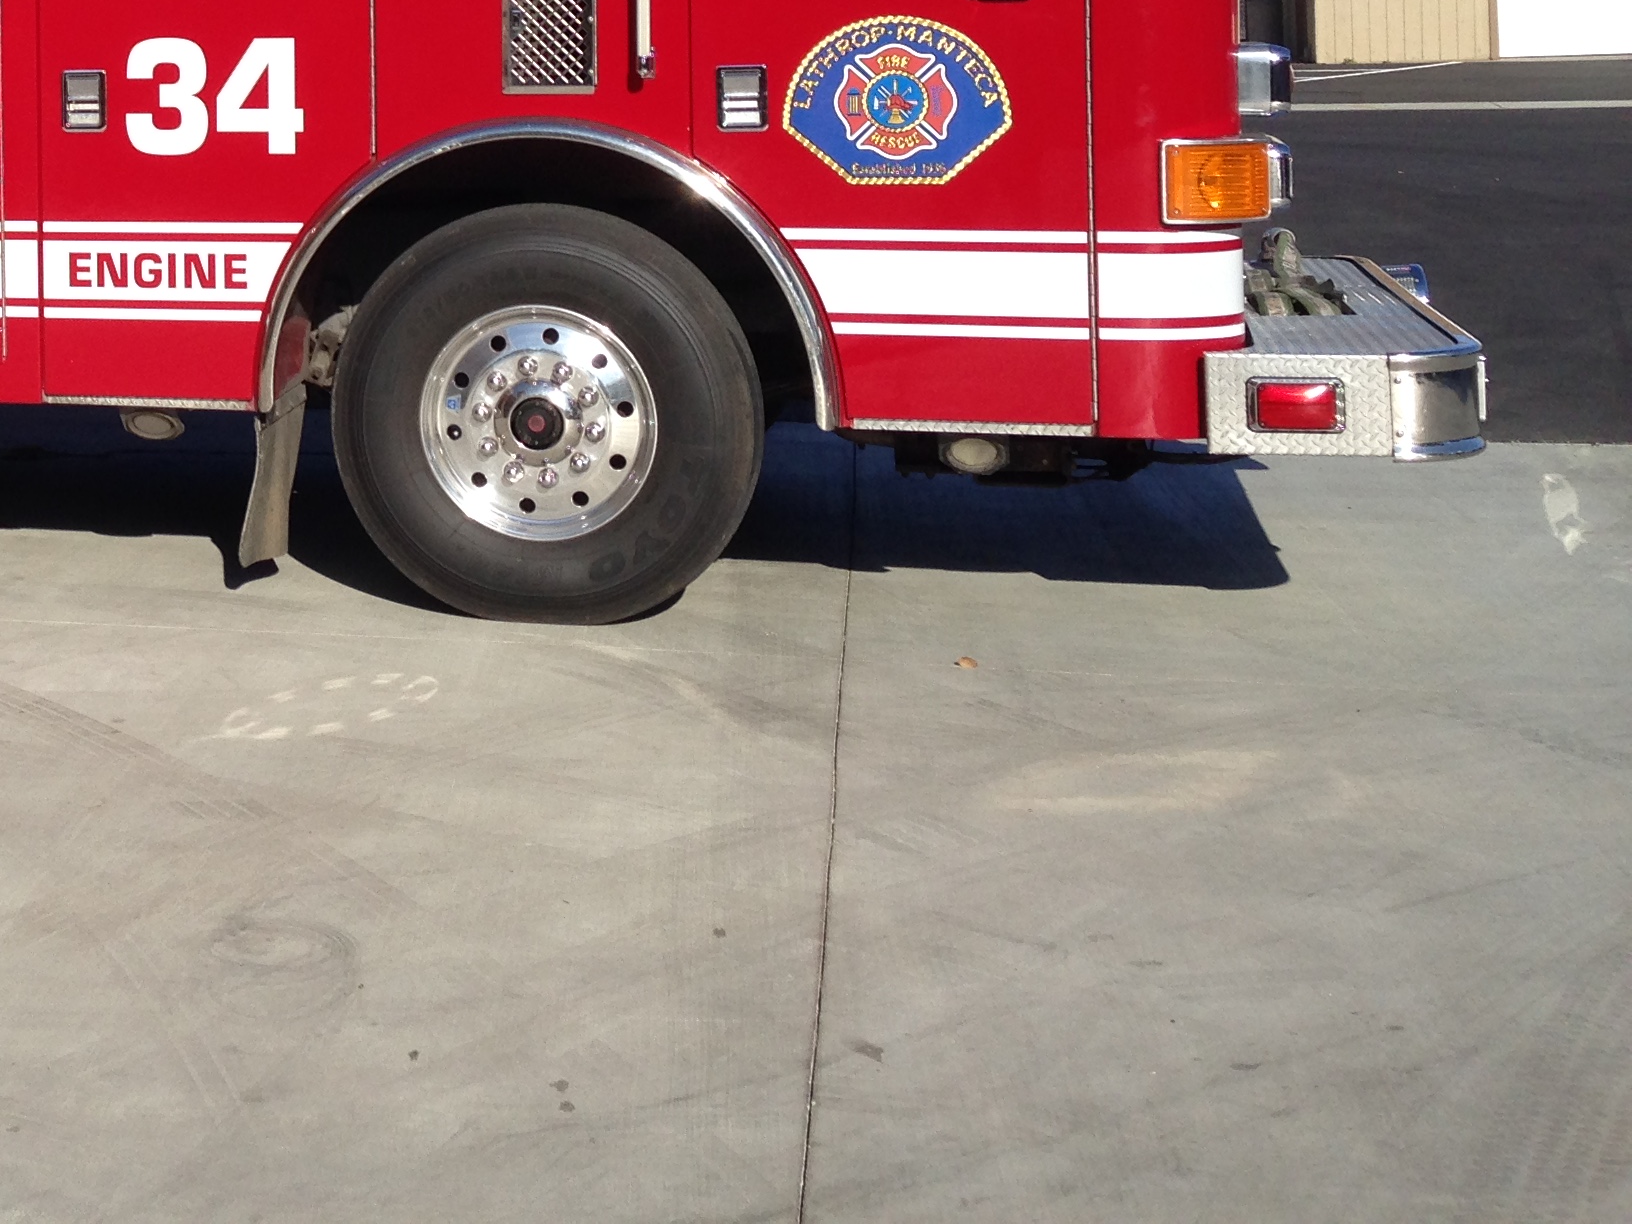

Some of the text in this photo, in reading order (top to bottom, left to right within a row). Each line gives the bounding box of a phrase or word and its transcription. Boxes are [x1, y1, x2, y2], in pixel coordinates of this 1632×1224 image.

[876, 54, 911, 70] FIRE
[125, 36, 305, 156] 34
[870, 130, 922, 150] RESCUE
[68, 252, 248, 289] ENGINE
